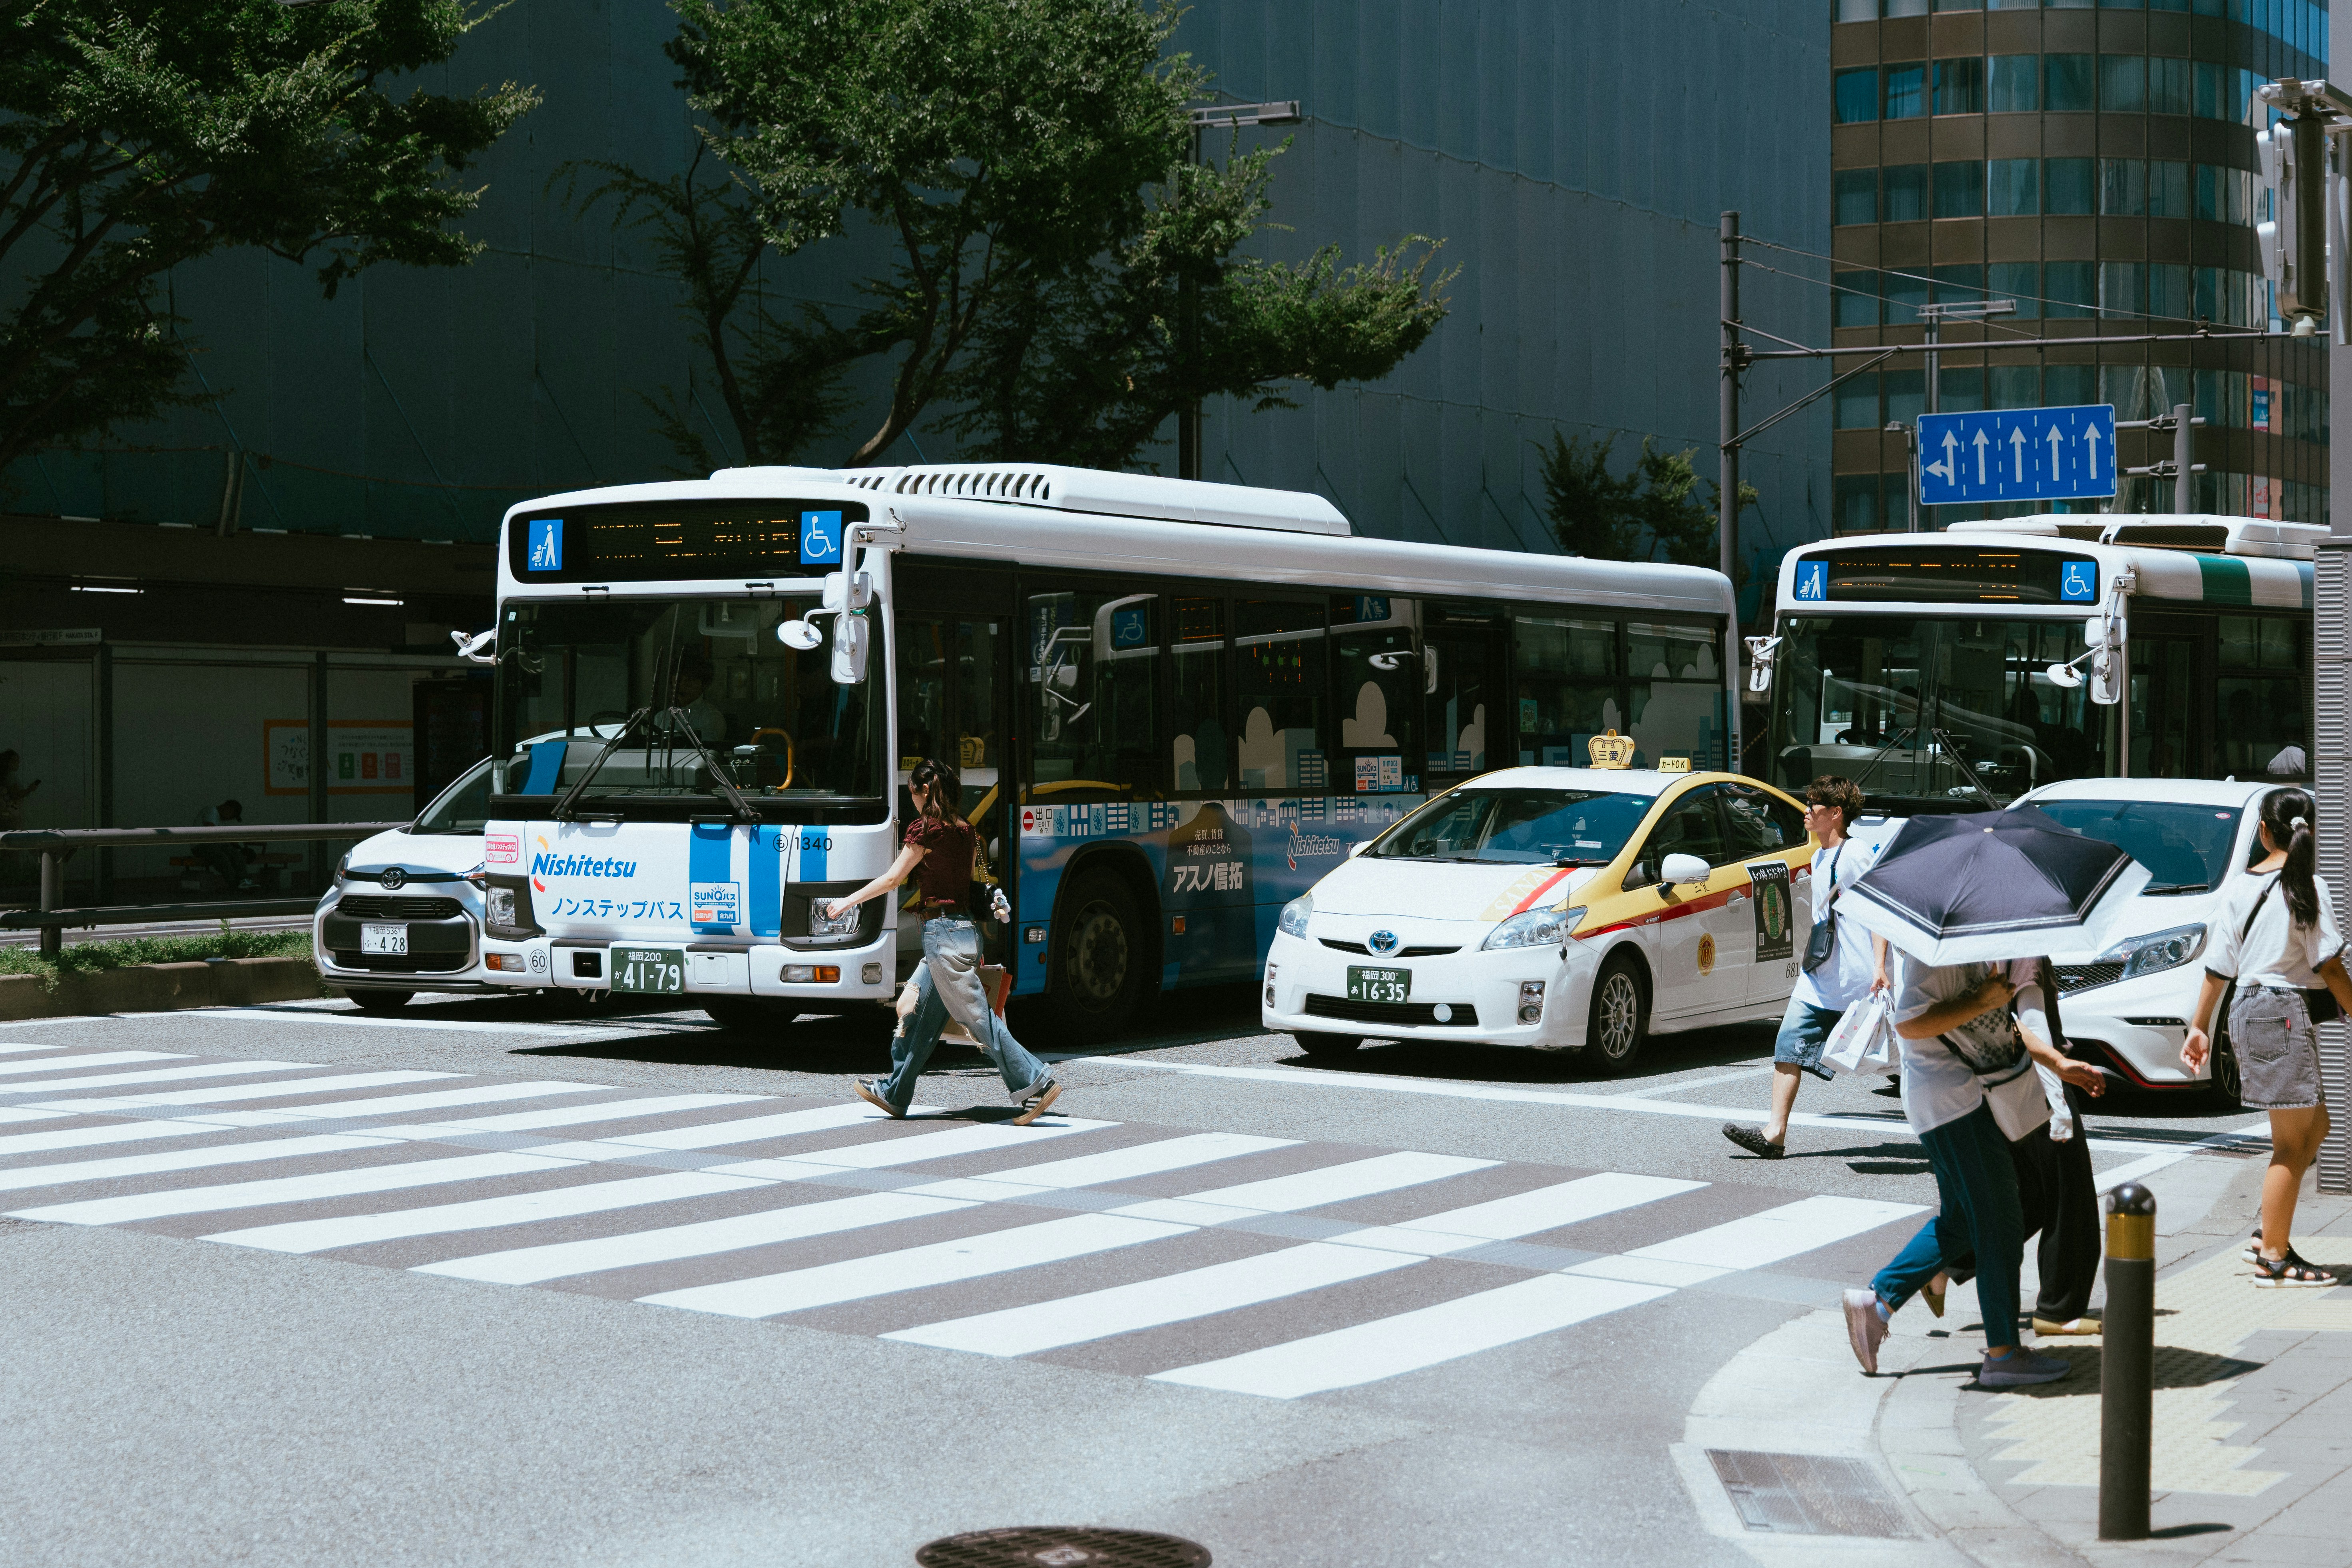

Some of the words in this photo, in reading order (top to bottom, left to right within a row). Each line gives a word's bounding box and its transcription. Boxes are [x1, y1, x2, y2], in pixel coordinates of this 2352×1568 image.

[1598, 751, 1618, 761] 三愛
[1357, 764, 1377, 772] SUNQパス
[1662, 760, 1685, 769] カードOK
[1036, 807, 1052, 820] 出口
[1195, 829, 1223, 841] 売買、賃貸
[795, 837, 832, 851] 1340
[1187, 844, 1231, 856] 不動産のことなら
[1287, 835, 1340, 857] Nishitetsu
[531, 853, 637, 878] Nishitetsu
[1174, 862, 1243, 893] アスノ信拓
[694, 890, 735, 901] SUNQパス
[552, 898, 683, 919] ノンステップバス
[532, 955, 546, 968] 60
[644, 952, 662, 962] 200
[614, 970, 622, 980] か
[623, 962, 680, 991] 41-79
[1362, 970, 1379, 980] 福岡
[1380, 971, 1396, 981] 300
[1786, 962, 1799, 979] 681
[1351, 985, 1358, 994] あ
[1363, 982, 1405, 1002] 16-35
